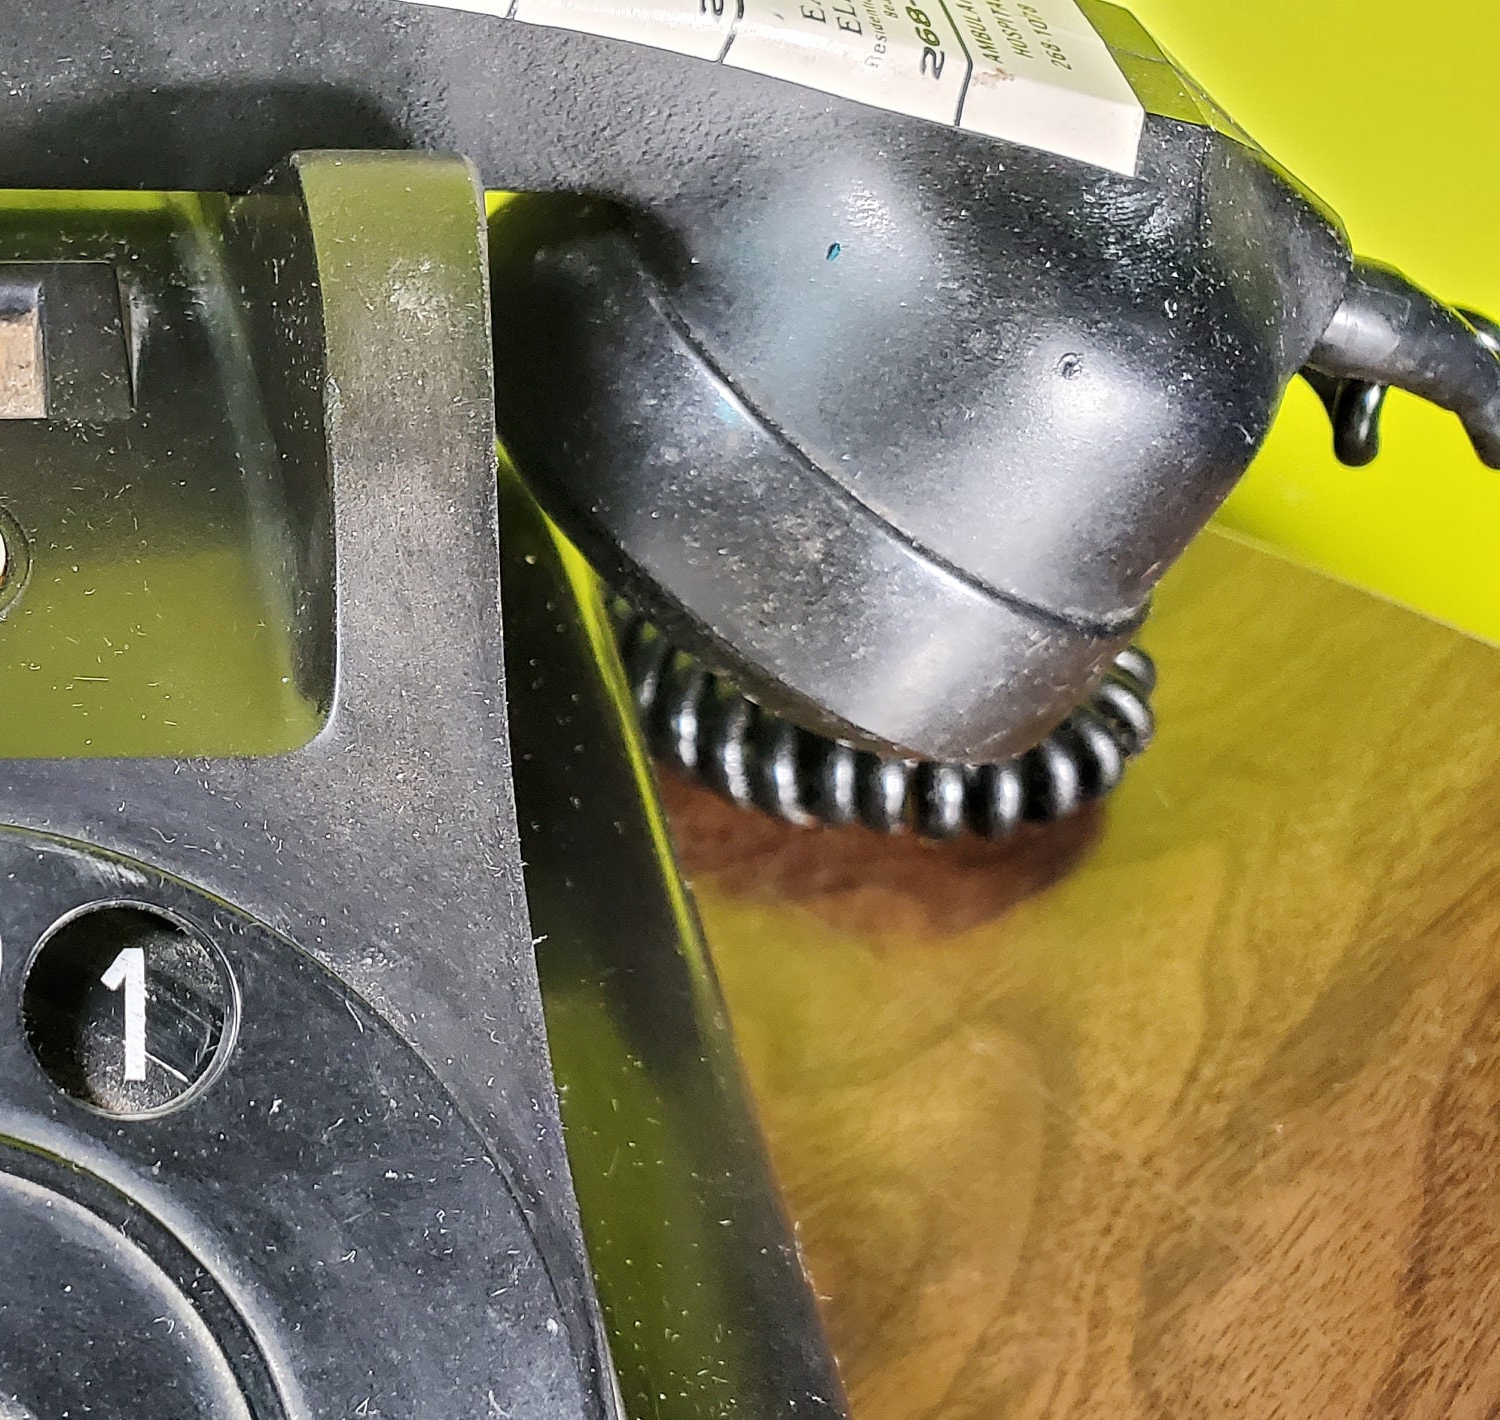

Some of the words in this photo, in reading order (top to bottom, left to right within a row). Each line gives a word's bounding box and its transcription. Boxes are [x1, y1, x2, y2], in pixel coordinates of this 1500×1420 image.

[832, 0, 864, 36] EL
[986, 0, 1035, 59] HOSPITA
[100, 946, 147, 1082] 1
